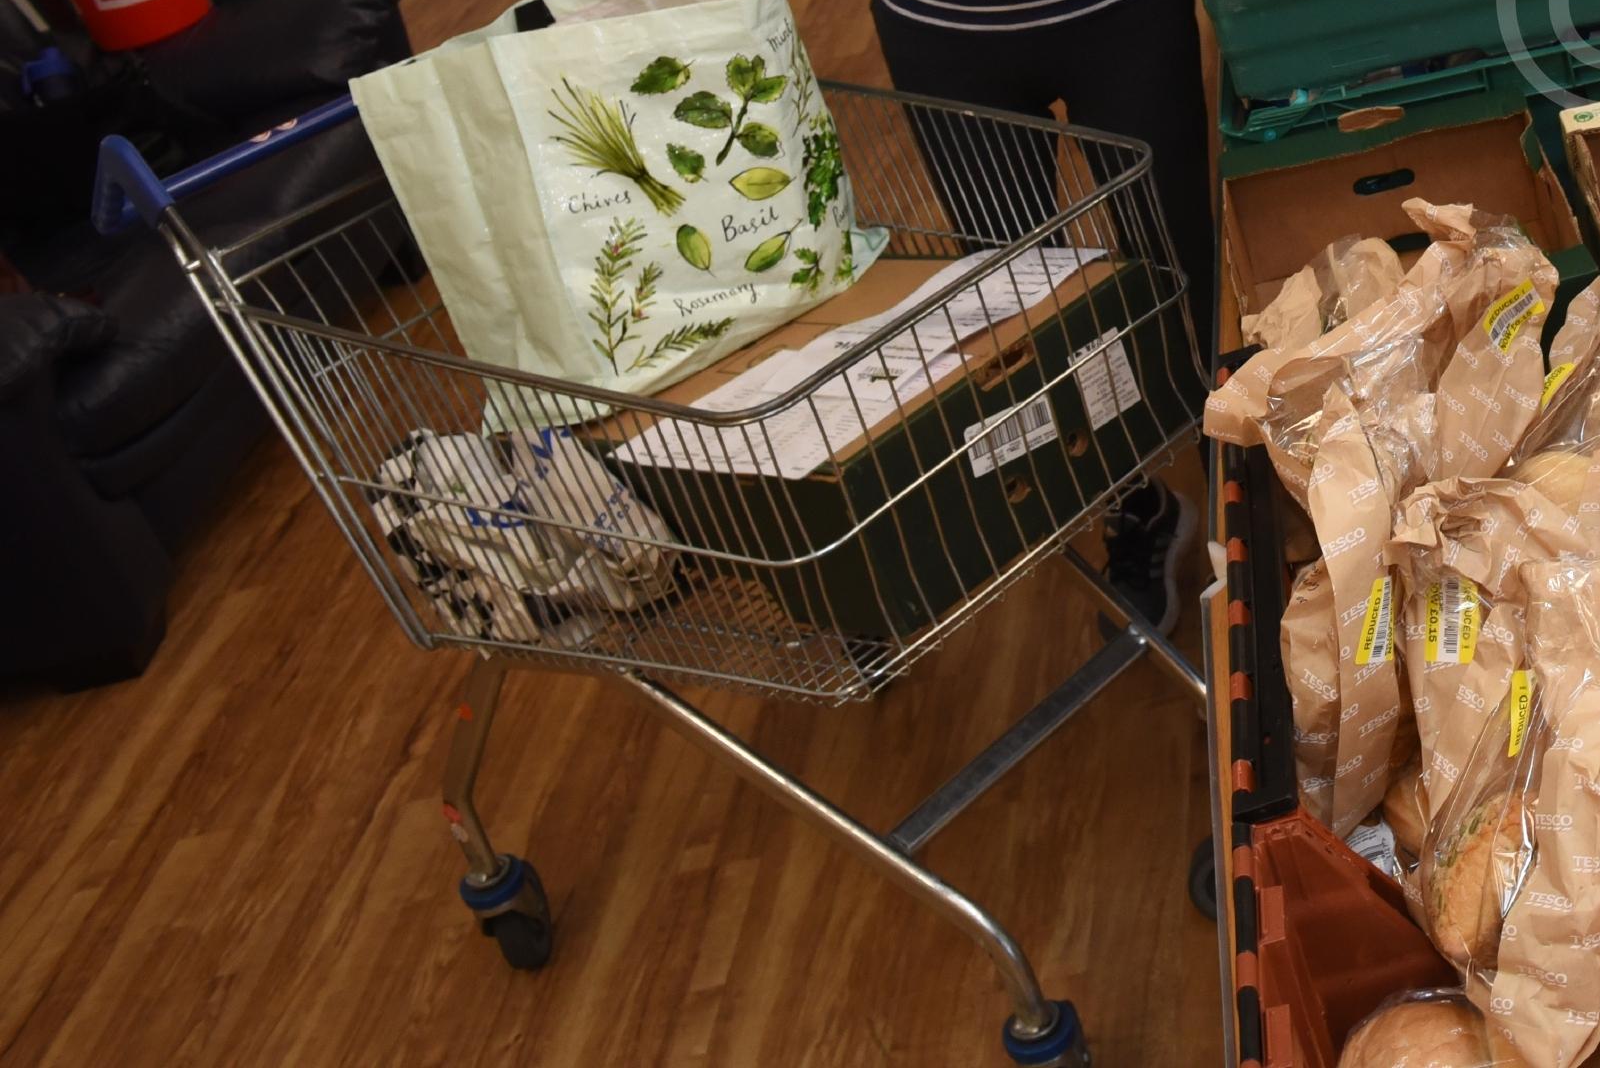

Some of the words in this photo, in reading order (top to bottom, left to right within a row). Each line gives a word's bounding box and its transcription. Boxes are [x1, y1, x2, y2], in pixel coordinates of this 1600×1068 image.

[568, 189, 632, 214] Chives
[721, 206, 779, 242] Basil
[673, 282, 758, 317] Rosemary
[1470, 385, 1502, 412] TESCO
[1504, 384, 1538, 408] TESCO
[1459, 432, 1488, 459] TESCO
[1494, 432, 1514, 451] TES
[1348, 478, 1379, 500] TES
[1320, 527, 1365, 555] TESCO
[1364, 597, 1381, 651] REDUCED
[1428, 609, 1439, 643] £0.15
[1303, 668, 1339, 700] TESCO
[1459, 684, 1486, 709] ESCO
[1359, 705, 1399, 733] TESCO
[1535, 814, 1573, 827] TESCO
[1528, 891, 1575, 909] TESCO
[1567, 1009, 1599, 1022] TES
